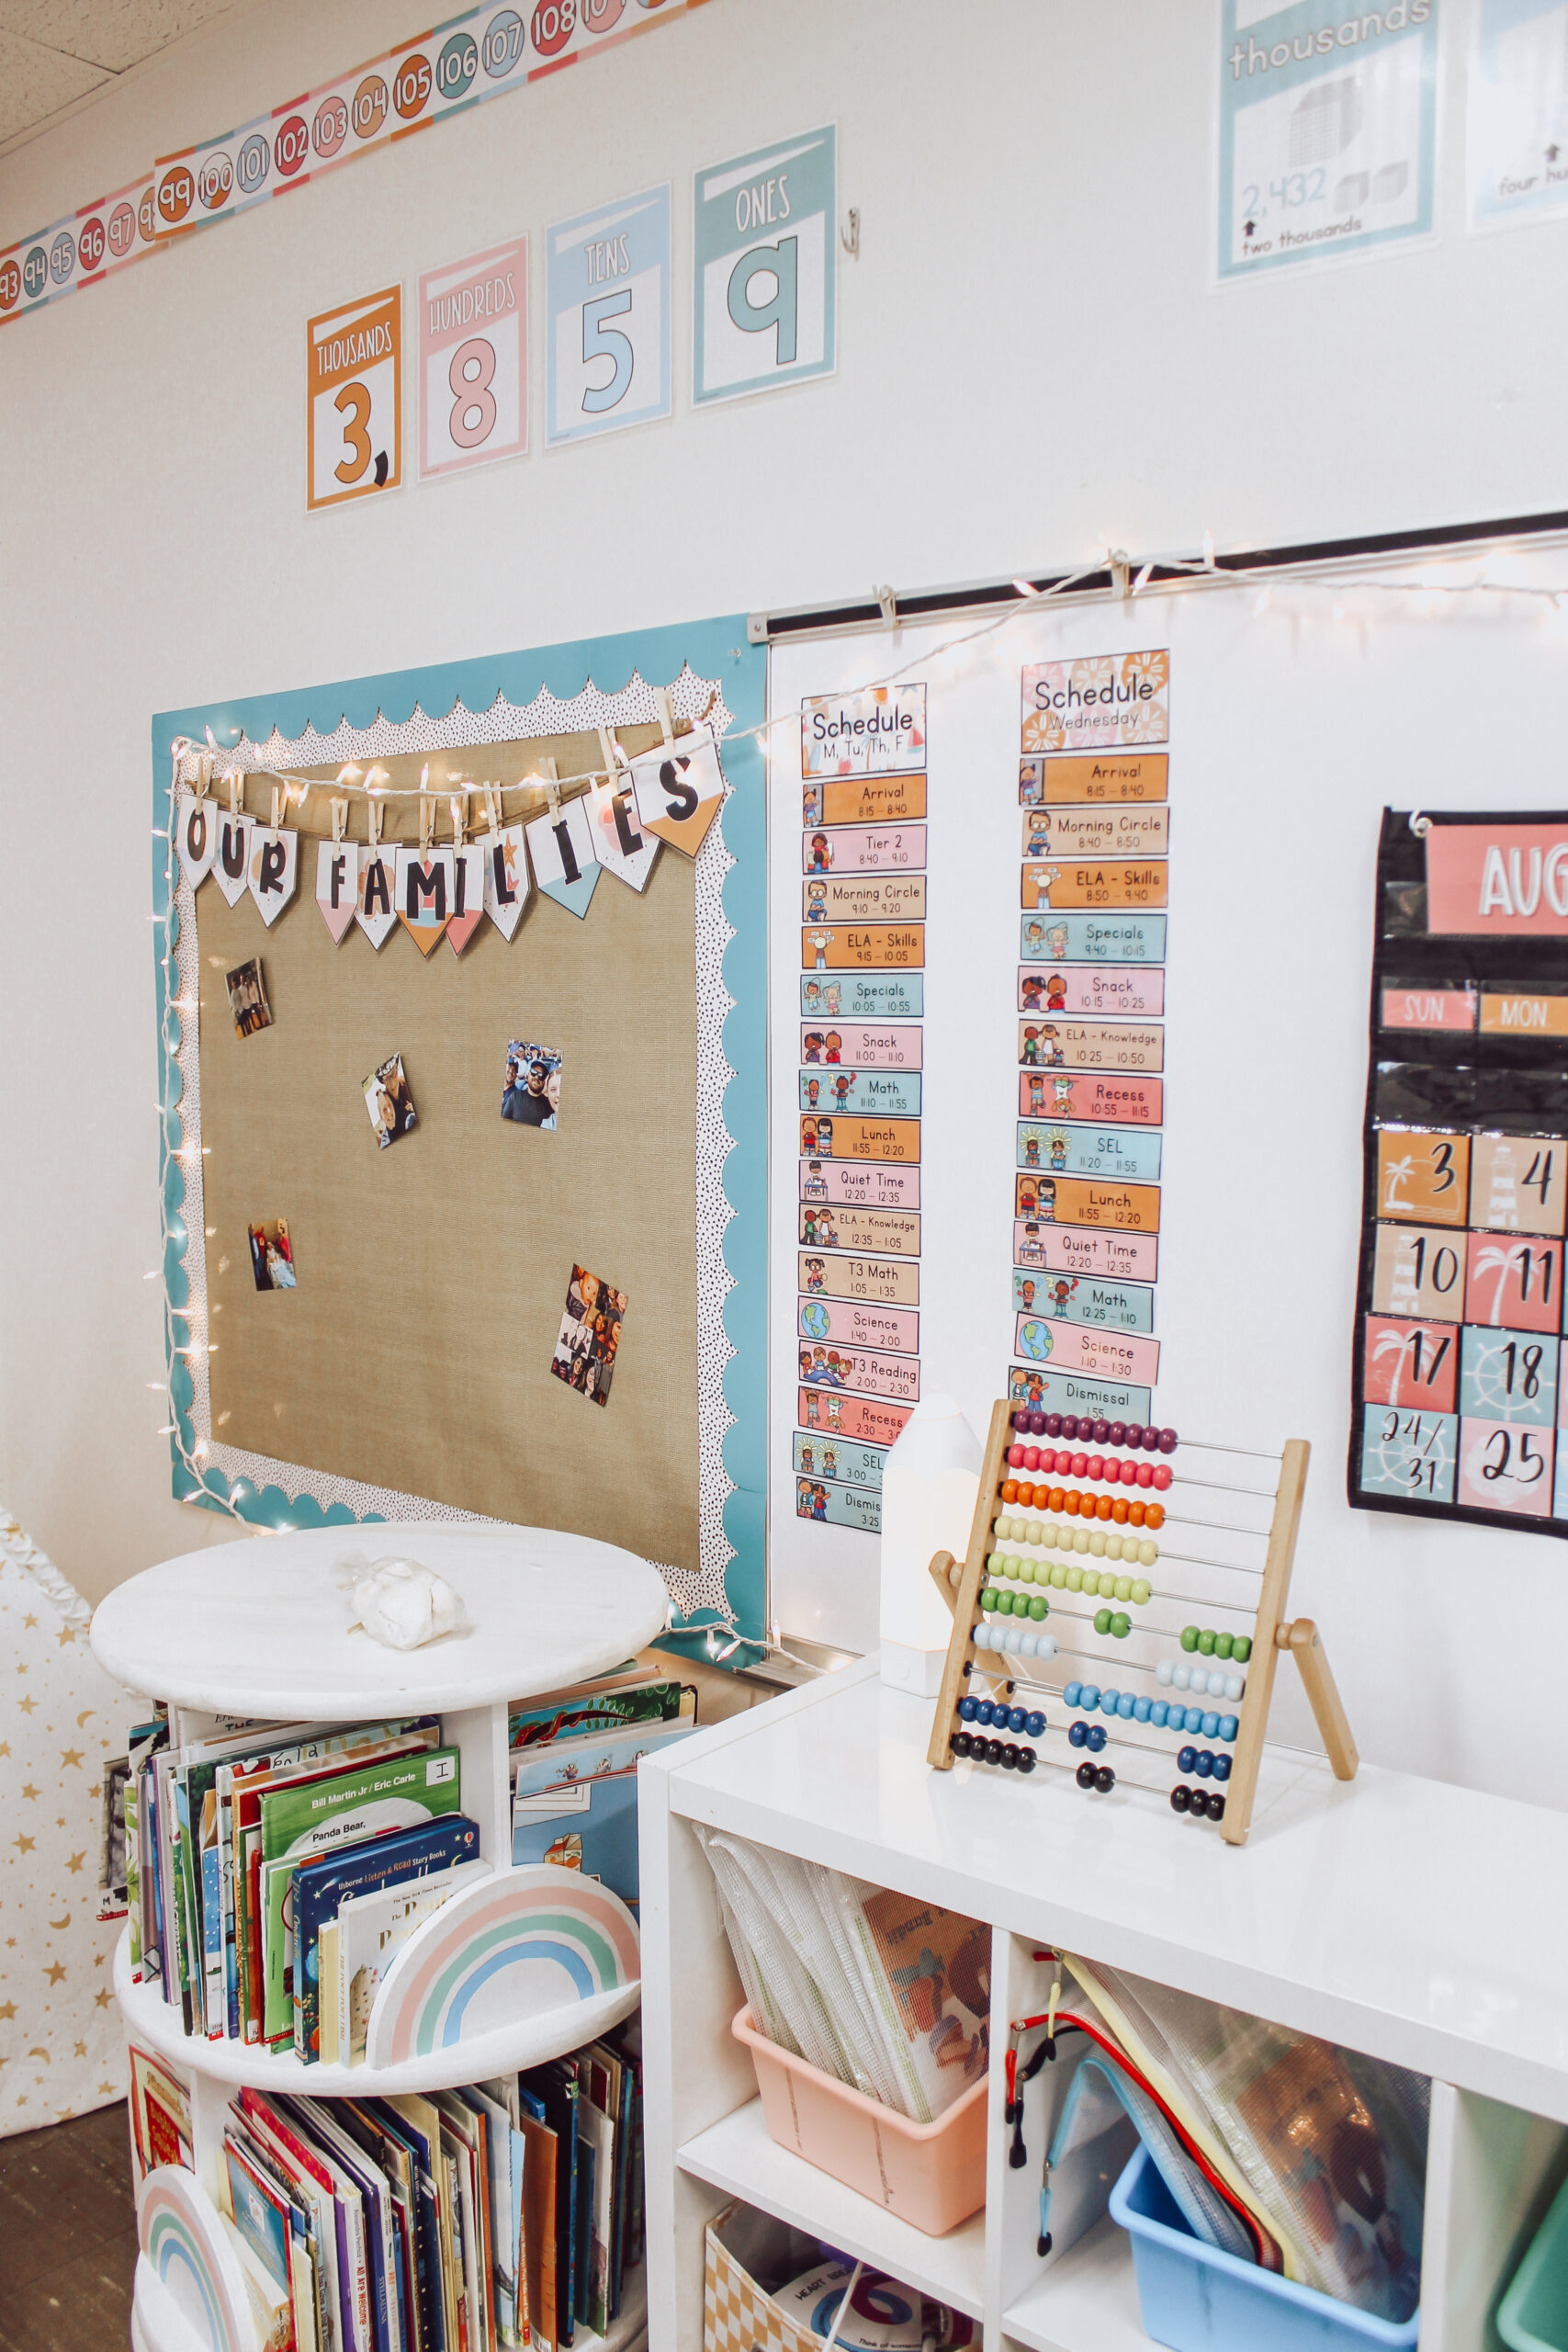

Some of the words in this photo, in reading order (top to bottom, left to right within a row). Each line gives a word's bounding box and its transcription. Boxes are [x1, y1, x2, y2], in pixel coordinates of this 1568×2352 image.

[1228, 0, 1431, 80] thousands
[0, 270, 18, 301] 93
[24, 255, 46, 289] 94
[51, 242, 73, 276] 95
[80, 228, 103, 260] 96
[109, 214, 133, 247] 97
[159, 175, 191, 212] 99
[199, 161, 233, 200] 100
[239, 142, 269, 186] 101
[276, 127, 310, 169] 102
[314, 102, 348, 147] 103
[352, 80, 389, 126] 104
[395, 62, 431, 105] 105
[438, 40, 478, 86] 106
[483, 21, 524, 70] 107
[534, 2, 576, 46] 108
[1242, 168, 1327, 219] 2,432
[1499, 175, 1538, 197] four
[736, 175, 791, 232] ONES
[1242, 240, 1271, 257] two
[1280, 216, 1362, 249] thousands
[584, 234, 630, 286] TENS
[430, 273, 515, 335] HUNDREDS
[727, 235, 797, 365] 9
[317, 322, 392, 376] THOUSANDS
[581, 288, 634, 413] 5
[449, 338, 497, 448] 8
[1035, 673, 1153, 710] Schedule
[813, 705, 912, 740] Schedule
[1050, 709, 1139, 729] Wednesday
[824, 743, 839, 759] M,
[845, 741, 863, 757] Tu,
[870, 737, 890, 754] Th,
[896, 735, 904, 751] F
[1092, 764, 1141, 778] Arrival
[863, 785, 904, 800] Arrival
[859, 806, 874, 816] 8:15
[887, 804, 907, 814] 8:40
[1058, 820, 1113, 834] Morning
[1120, 816, 1161, 831] Circle
[186, 808, 286, 895] OUR
[330, 756, 700, 922] FAMILIES
[866, 836, 889, 849] Tier
[895, 835, 902, 848] 2
[1077, 871, 1104, 885] ELA
[1125, 871, 1159, 885] Skills
[833, 888, 879, 901] Morning
[886, 885, 919, 898] Circle
[1087, 890, 1109, 900] 8:50
[1125, 889, 1147, 900] 9:40
[848, 934, 871, 947] ELA
[888, 933, 917, 947] Skills
[1087, 924, 1144, 941] Specials
[856, 952, 872, 961] 9:15
[885, 952, 908, 961] 10:05
[1085, 945, 1107, 956] 9:40
[857, 982, 904, 998] Specials
[1093, 978, 1133, 991] Snack
[852, 1002, 875, 1012] 10:05
[888, 1001, 909, 1012] 10:55
[863, 1034, 897, 1047] Snack
[1067, 1029, 1087, 1040] ELA
[1101, 1032, 1156, 1046] Knowledge
[856, 1051, 874, 1061] 11:00
[888, 1053, 904, 1062] 11:10
[1077, 1051, 1101, 1061] 10:25
[1118, 1052, 1145, 1063] 10:50
[869, 1080, 899, 1094] Math
[1097, 1085, 1145, 1102] Recess
[861, 1098, 875, 1108] 11:10
[889, 1099, 907, 1109] 11:55
[1091, 1103, 1116, 1114] 10:55
[1133, 1106, 1149, 1117] 11:15
[862, 1126, 896, 1141] Lunch
[853, 1143, 870, 1153] 11:55
[883, 1145, 904, 1156] 12:20
[1098, 1138, 1122, 1153] SEL
[841, 1171, 871, 1185] Quiet
[876, 1173, 904, 1187] Time
[1431, 1142, 1455, 1193] 3
[1521, 1149, 1552, 1204] 4
[845, 1190, 865, 1200] 12:20
[878, 1192, 899, 1203] 12:35
[1090, 1191, 1131, 1207] Lunch
[840, 1214, 857, 1225] ELA
[868, 1217, 915, 1232] Knowledge
[1079, 1208, 1100, 1220] 11:55
[1116, 1212, 1141, 1224] 12:20
[852, 1234, 872, 1245] 12:35
[886, 1238, 901, 1248] 1:05
[1063, 1236, 1098, 1250] Quiet
[1105, 1240, 1137, 1258] Time
[849, 1262, 863, 1276] T3
[868, 1265, 897, 1280] Math
[1067, 1256, 1091, 1268] 12:20
[1107, 1261, 1132, 1272] 12:35
[1410, 1237, 1458, 1293] 10
[1516, 1248, 1553, 1305] 11
[851, 1283, 866, 1294] 1:05
[880, 1286, 895, 1296] 1:35
[1093, 1289, 1127, 1307] Math
[853, 1313, 897, 1330] Science
[1083, 1306, 1105, 1319] 12:25
[1122, 1313, 1136, 1324] 1:10
[852, 1331, 866, 1341] 1:40
[880, 1335, 900, 1346] 2:00
[1082, 1336, 1134, 1359] Science
[852, 1358, 866, 1372] T3
[871, 1362, 917, 1383] Reading
[1081, 1356, 1097, 1368] 1:10
[1112, 1363, 1131, 1375] 1:30
[1407, 1330, 1451, 1387] 17
[1500, 1341, 1543, 1399] 18
[857, 1377, 876, 1388] 2:00
[890, 1383, 908, 1394] 2:30
[1067, 1384, 1129, 1405] Dismissal
[863, 1408, 903, 1428] Recess
[1088, 1408, 1104, 1419] 1:55
[856, 1424, 874, 1435] 2:30
[863, 1454, 884, 1470] SEL
[1483, 1430, 1543, 1483] 25
[847, 1469, 866, 1480] 3:00
[1408, 1459, 1437, 1494] 31
[862, 1515, 879, 1527] 3:25
[435, 1762, 448, 1778] I
[312, 1797, 326, 1809] Bill
[328, 1789, 356, 1805] Martin
[358, 1787, 367, 1796] Jr
[374, 1778, 391, 1792] Eric
[393, 1773, 415, 1785] Carle
[312, 1827, 341, 1842] Panda
[344, 1820, 366, 1834] Bear,
[338, 1877, 363, 1890] Usborne
[365, 1871, 386, 1883] Listen
[394, 1860, 411, 1871] Read
[412, 1855, 427, 1866] Story
[429, 1850, 446, 1860] Books
[356, 2267, 366, 2275] All
[357, 2278, 367, 2290] Are
[795, 2278, 825, 2301] HEART
[358, 2292, 368, 2325] Welcome
